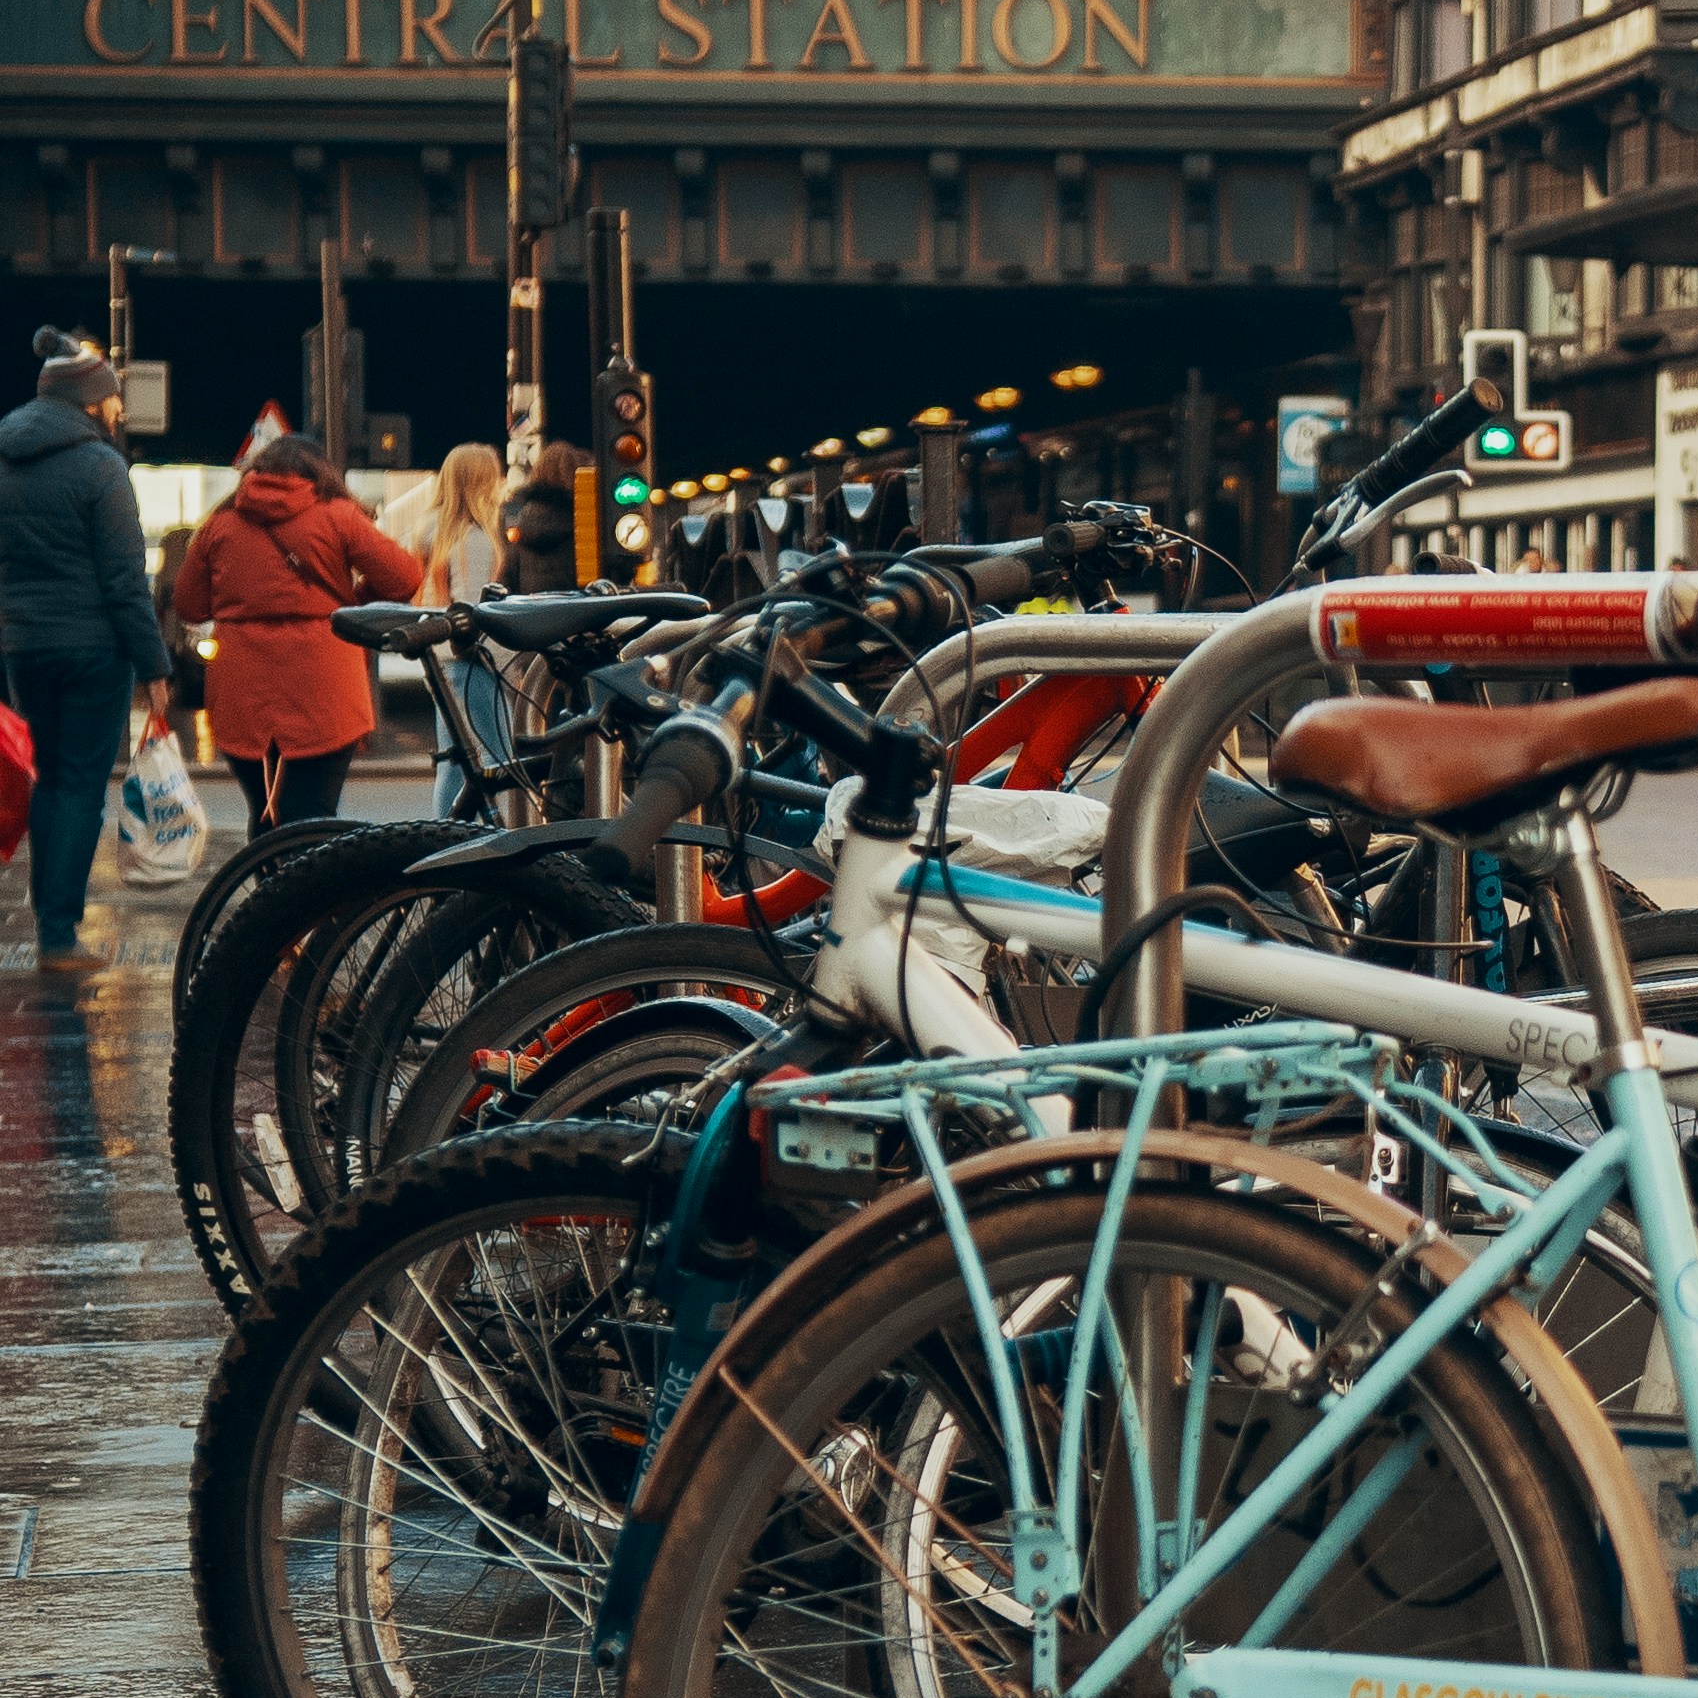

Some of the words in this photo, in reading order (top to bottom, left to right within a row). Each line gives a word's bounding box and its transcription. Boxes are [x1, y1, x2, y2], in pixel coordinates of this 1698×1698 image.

[1469, 591, 1529, 610] approved
[1530, 594, 1542, 609] is
[1545, 594, 1571, 611] lock
[1571, 591, 1601, 606] your
[1604, 594, 1644, 611] Check
[193, 1182, 252, 1297] AXXIS
